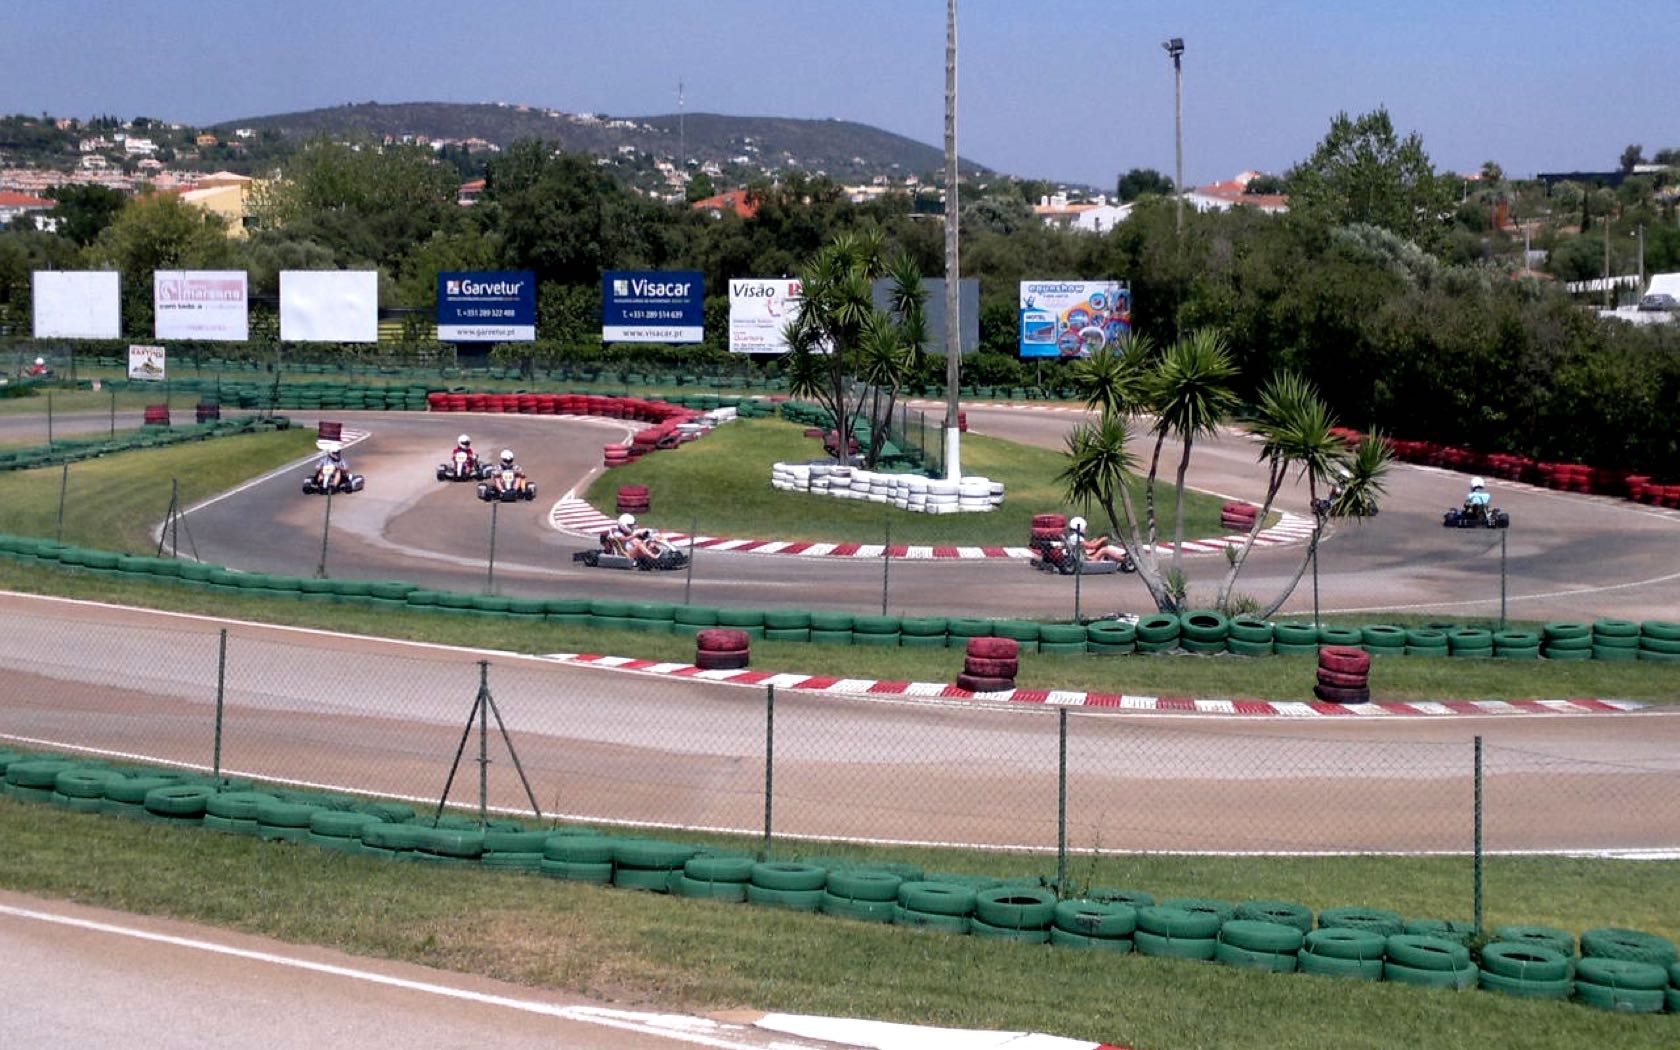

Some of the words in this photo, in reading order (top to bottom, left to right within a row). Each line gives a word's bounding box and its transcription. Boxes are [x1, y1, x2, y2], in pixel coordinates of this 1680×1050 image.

[462, 280, 520, 295] Garvetur
[632, 279, 691, 297] Visacar
[733, 282, 775, 298] Visão
[457, 329, 516, 337] www.garvetur.pt
[622, 330, 683, 338] www.visacar.pt
